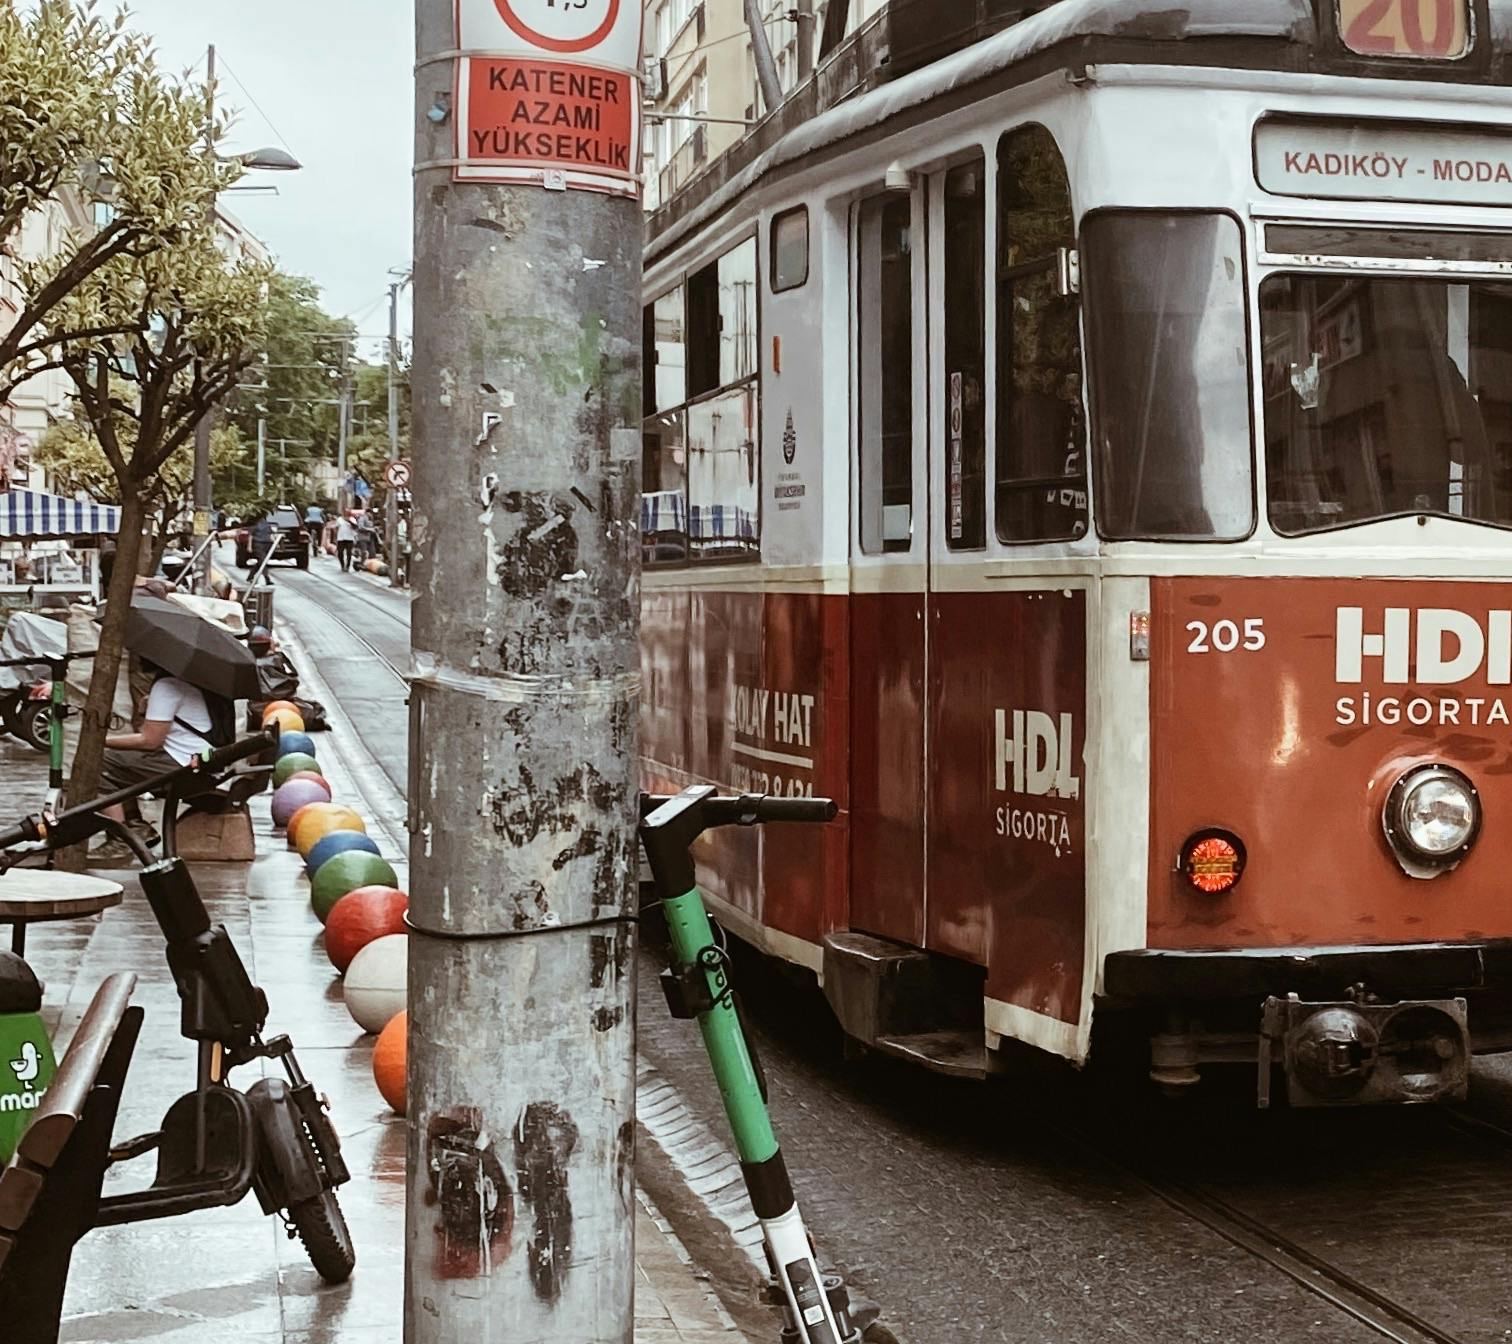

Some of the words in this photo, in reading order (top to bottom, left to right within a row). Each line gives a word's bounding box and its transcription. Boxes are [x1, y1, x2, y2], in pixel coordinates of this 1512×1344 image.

[489, 67, 619, 104] KATENER
[511, 100, 600, 132] AZAMİ
[472, 125, 628, 168] YÜKSEKLİK
[1283, 150, 1409, 180] KADIKÖY
[1432, 159, 1512, 183] MODA
[1185, 617, 1267, 654] 205
[1335, 606, 1512, 685] HDI
[774, 690, 815, 747] HAT
[1335, 691, 1511, 726] SİGORTA
[996, 802, 1072, 846] SİGORTA
